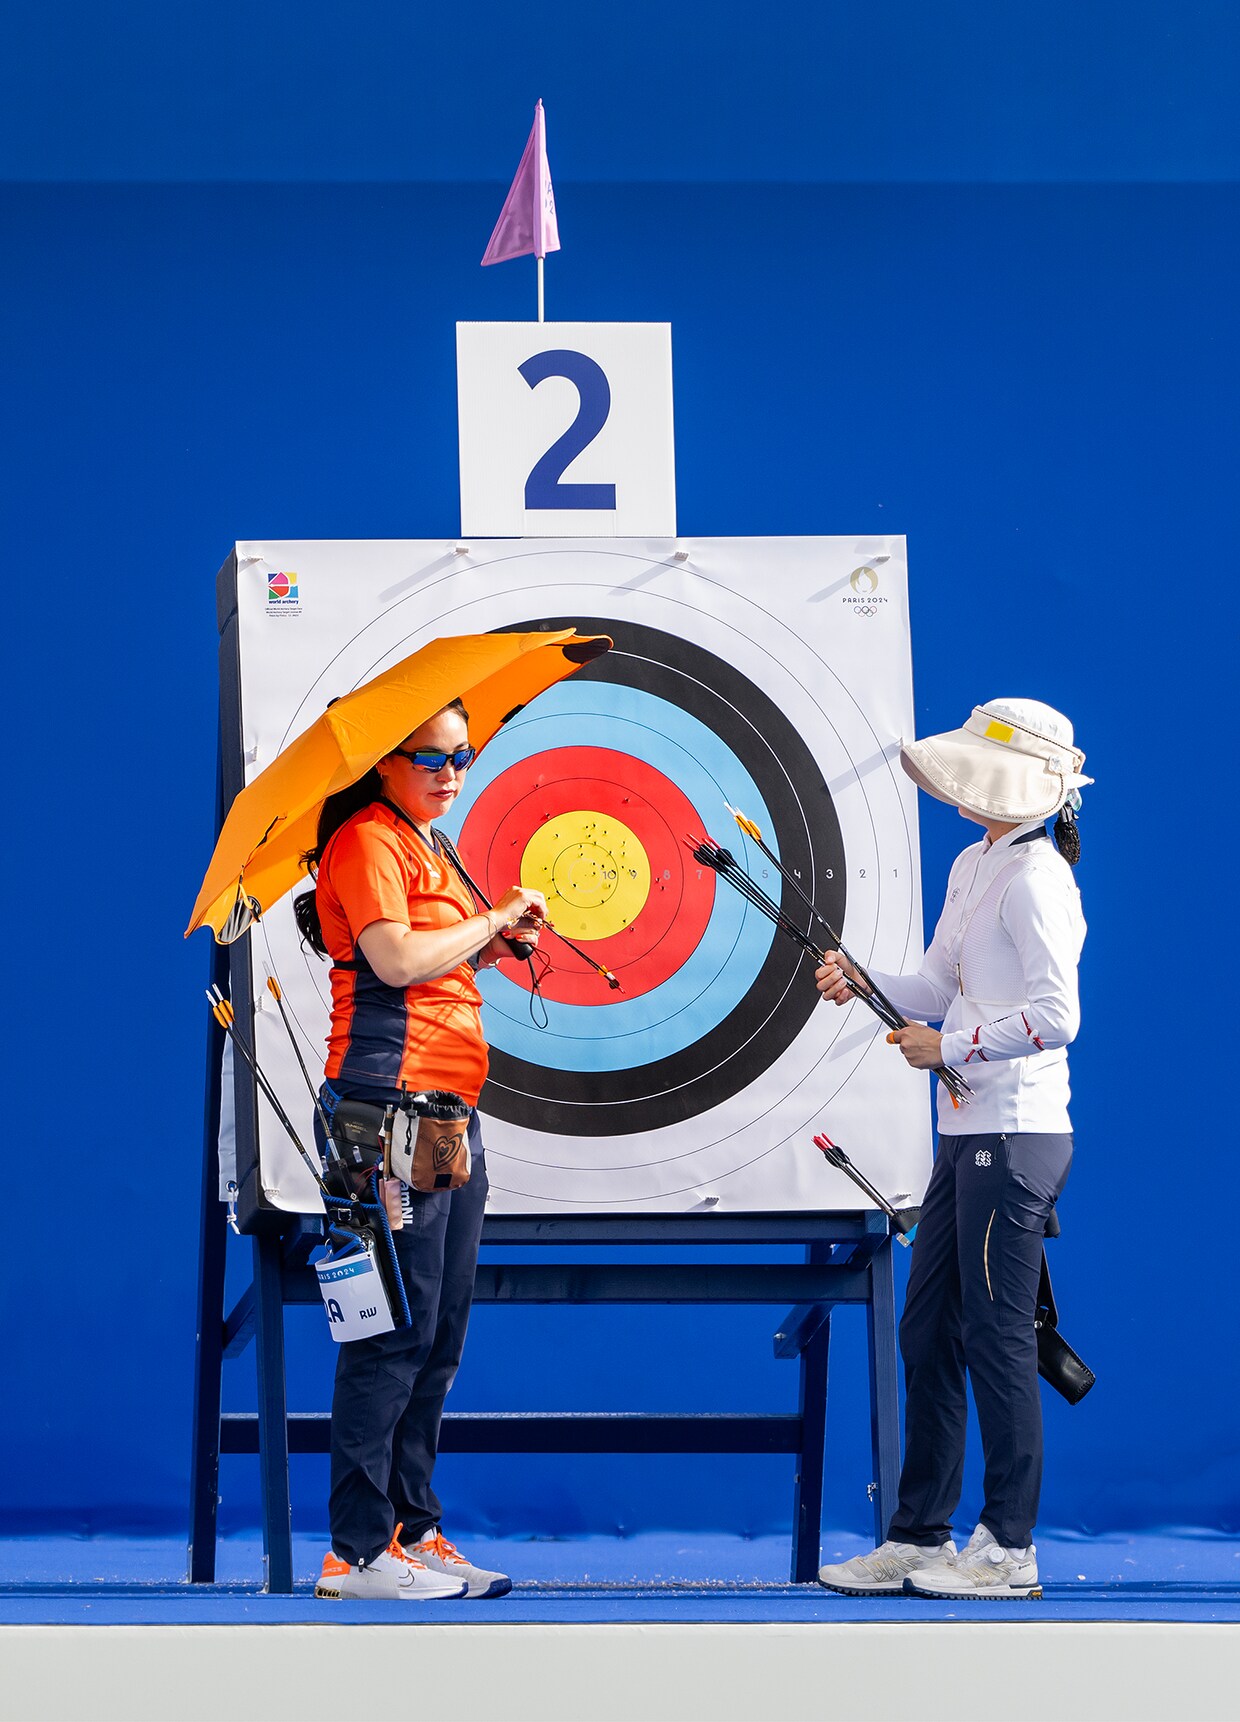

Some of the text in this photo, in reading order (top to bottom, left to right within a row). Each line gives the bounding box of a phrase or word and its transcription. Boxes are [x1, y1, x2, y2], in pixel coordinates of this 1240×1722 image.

[517, 349, 616, 510] 2
[603, 868, 898, 880] 10 9 8 7 5 4 3 2 1
[332, 1267, 354, 1279] 2024
[326, 1298, 345, 1323] A
[359, 1307, 377, 1320] RW
